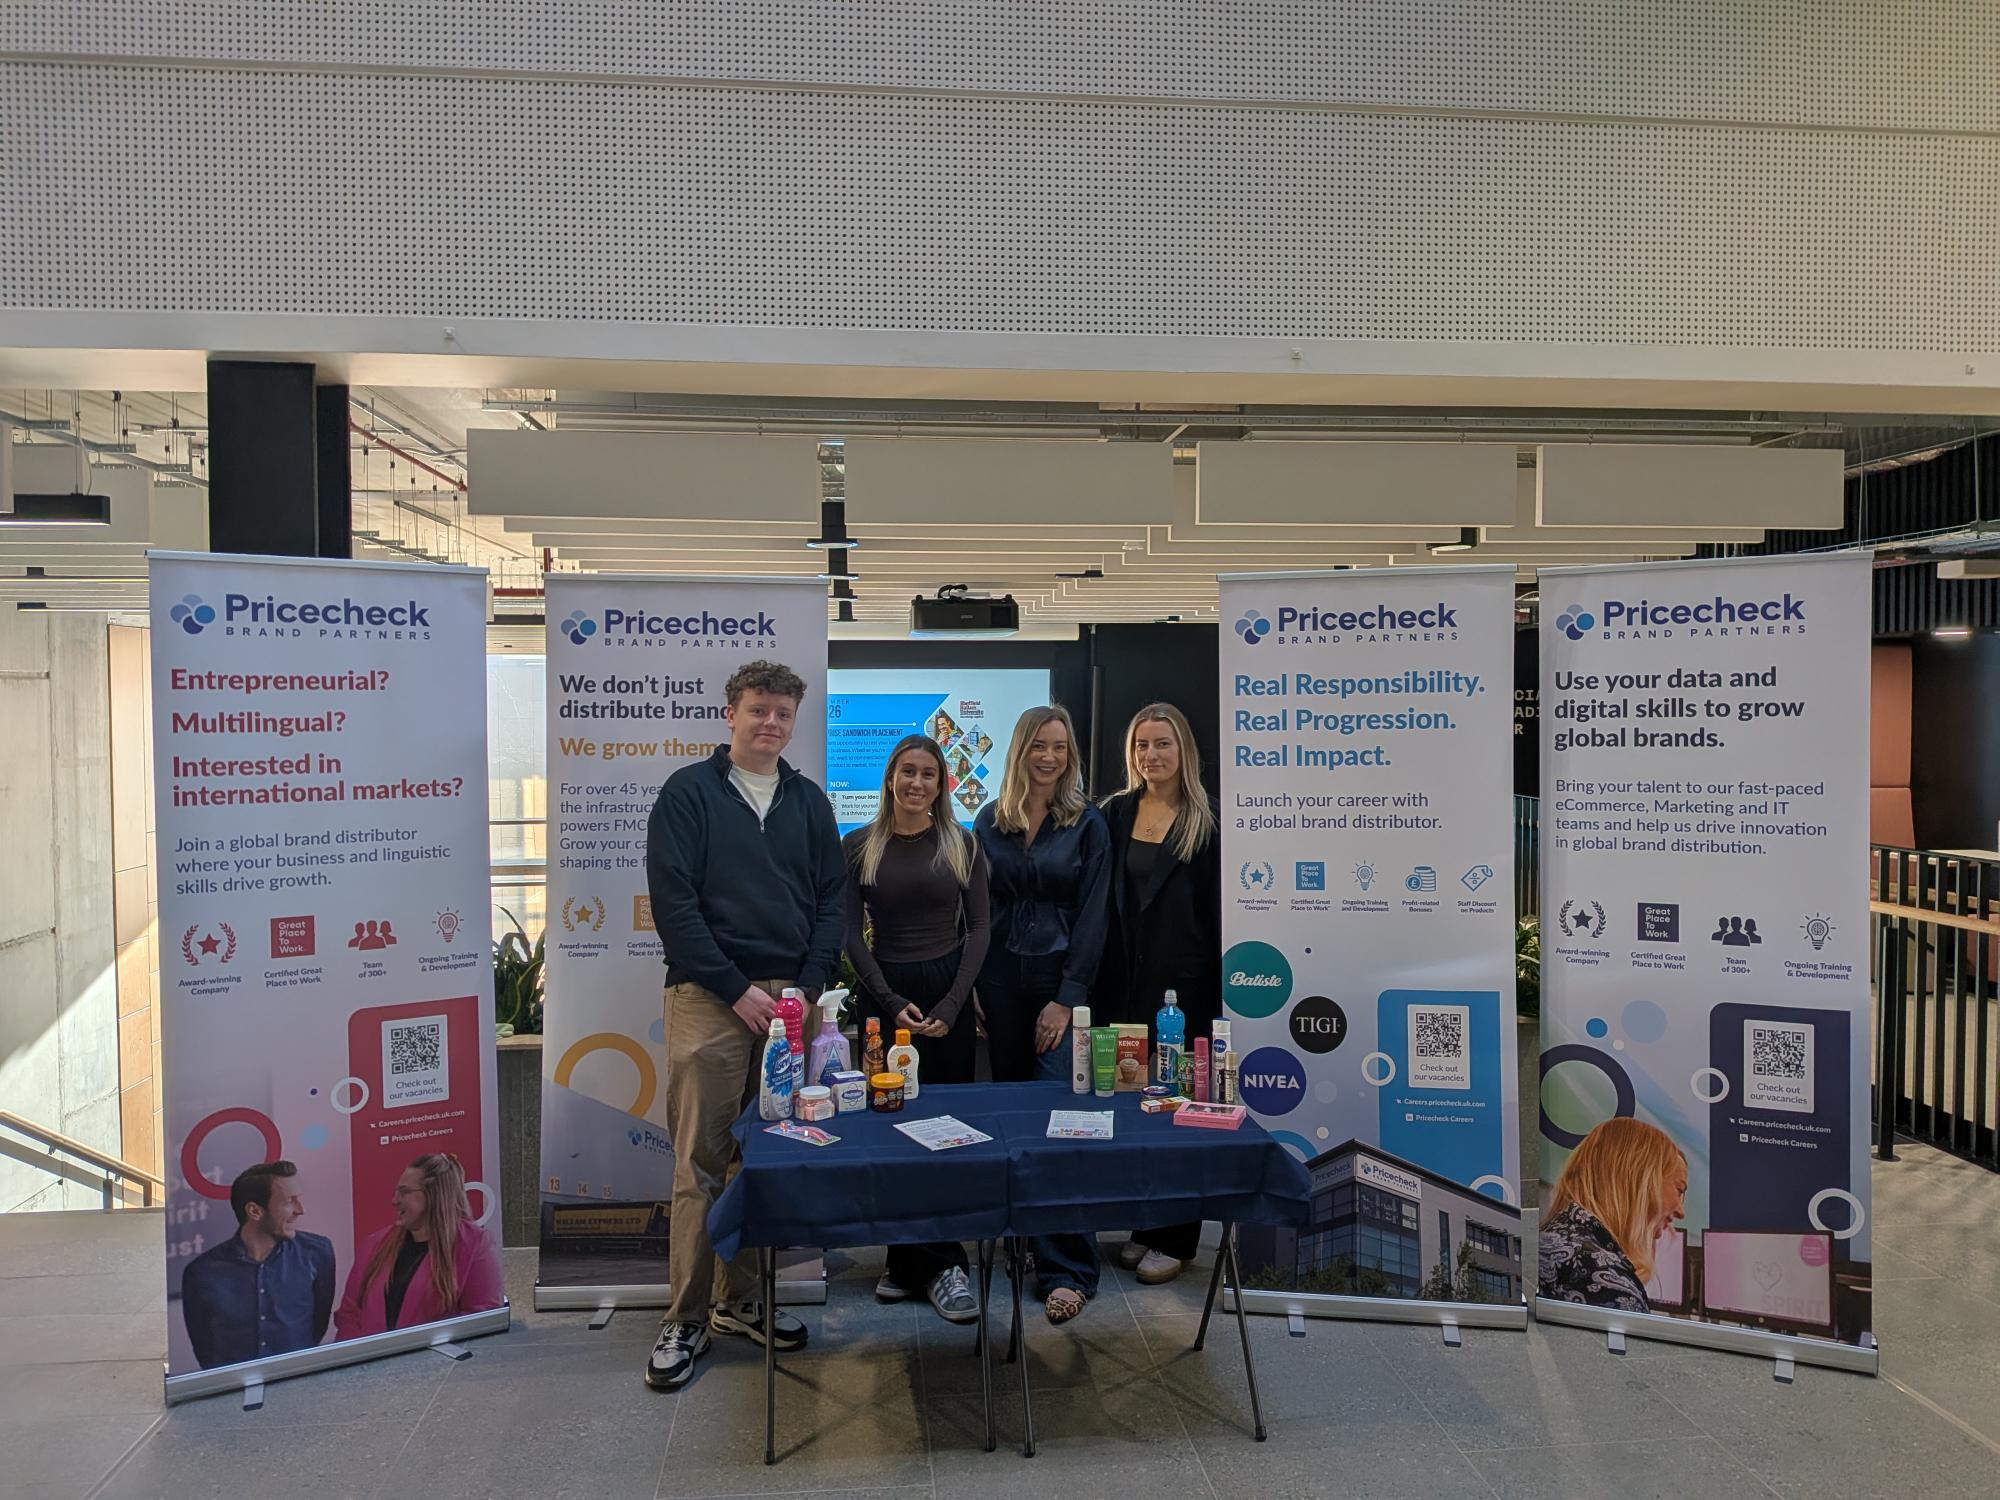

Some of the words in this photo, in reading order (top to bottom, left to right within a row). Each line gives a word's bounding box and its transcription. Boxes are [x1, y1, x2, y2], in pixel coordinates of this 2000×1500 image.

[225, 594, 431, 627] Pricecheck
[1278, 603, 1457, 632] Pricecheck
[1604, 593, 1805, 627] Pricecheck
[604, 609, 776, 637] Pricecheck
[226, 627, 301, 637] BRAND
[320, 629, 431, 640] PARTNERS
[1278, 635, 1341, 644] BRAND
[1356, 632, 1458, 642] PARTNERS
[1604, 628, 1673, 639] BRAND
[1691, 625, 1806, 637] PARTNERS
[605, 638, 666, 647] BRAND
[681, 640, 776, 648] PARTNERS
[171, 669, 390, 694] Entrepreneurial?
[560, 675, 596, 693] We
[603, 675, 658, 694] don't
[663, 676, 703, 697] just
[1235, 674, 1287, 696] Real
[1296, 671, 1484, 698] Responsibility.
[1555, 671, 1599, 689] Use
[1605, 674, 1661, 693] your
[1667, 668, 1722, 688] data
[1730, 666, 1776, 687] and
[560, 700, 665, 719] distribute
[1555, 699, 1628, 722] digital
[1635, 698, 1696, 718] skills
[1704, 699, 1730, 717] to
[1738, 702, 1804, 721] grow
[171, 712, 346, 736] Multilingual?
[1235, 709, 1287, 731] Real
[1296, 708, 1456, 734] Progression.
[1555, 728, 1626, 751] global
[1634, 727, 1724, 747] brands.
[560, 738, 595, 755] We
[602, 740, 657, 759] grow
[173, 754, 310, 777] Interested
[319, 753, 341, 773] in
[1235, 745, 1287, 766] Real
[1296, 745, 1391, 770] Impact.
[173, 780, 345, 806] international
[353, 777, 463, 800] markets?
[560, 784, 581, 795] For
[586, 786, 616, 795] over
[620, 784, 637, 795] 45
[1556, 780, 1594, 794] Bring
[1598, 782, 1632, 795] your
[1637, 780, 1681, 793] talent
[1686, 781, 1702, 794] to
[1707, 783, 1734, 795] our
[1738, 781, 1823, 797] fast-paced
[560, 801, 582, 813] the
[1236, 793, 1292, 807] Launch
[1297, 795, 1333, 810] your
[1337, 795, 1388, 807] career
[1393, 793, 1428, 807] with
[1556, 800, 1649, 814] eCommerce,
[1654, 800, 1734, 816] Marketing
[1739, 801, 1768, 814] and
[1773, 802, 1789, 814] IT
[560, 821, 609, 834] powers
[615, 820, 648, 831] FMC
[1236, 817, 1244, 829] a
[1249, 814, 1296, 831] global
[1301, 814, 1347, 828] brand
[1352, 814, 1442, 828] distributor.
[1556, 818, 1599, 830] teams
[1604, 818, 1632, 831] and
[1636, 819, 1669, 834] help
[1674, 821, 1691, 832] us
[1696, 820, 1736, 834] drive
[1740, 821, 1826, 836] innovation
[176, 837, 210, 852] Join
[215, 839, 224, 850] a
[230, 835, 279, 852] global
[284, 831, 330, 847] brand
[335, 827, 417, 844] distributor
[560, 838, 596, 850] Grow
[600, 840, 631, 852] your
[1556, 837, 1568, 848] in
[1573, 836, 1617, 851] global
[1622, 837, 1666, 851] brand
[1671, 838, 1766, 854] distribution.
[176, 857, 229, 872] where
[235, 855, 270, 871] your
[276, 852, 345, 867] business
[350, 848, 377, 863] and
[383, 845, 450, 862] linguistic
[560, 857, 611, 870] shaping
[616, 856, 638, 867] the
[176, 878, 217, 894] skills
[223, 875, 265, 891] drive
[270, 872, 331, 887] growth.
[1645, 907, 1670, 916] Great
[278, 921, 306, 930] Great
[279, 929, 306, 937] Place
[1646, 922, 1654, 930] To
[279, 937, 290, 945] To
[1646, 929, 1668, 938] Work
[279, 944, 304, 953] Work
[1556, 948, 1610, 958] Award-winning
[1566, 957, 1599, 966] Company
[1631, 952, 1663, 961] Certified
[1665, 953, 1686, 961] Great
[1726, 957, 1746, 965] Team
[1632, 960, 1653, 968] Place
[1664, 961, 1684, 970] Work
[1731, 966, 1751, 974] 300+
[1230, 972, 1282, 987] Batiste
[1296, 1016, 1338, 1033] TIGI
[1420, 1064, 1442, 1073] Check
[396, 1079, 421, 1089] Check
[423, 1078, 436, 1086] out
[1244, 1075, 1300, 1089] NIVEA
[1428, 1074, 1464, 1082] vacancies
[390, 1092, 402, 1100] our
[405, 1087, 443, 1098] vacancies
[1757, 1083, 1783, 1093] Check
[1786, 1085, 1800, 1094] out
[1750, 1092, 1764, 1100] our
[1766, 1093, 1807, 1105] vacancies
[392, 1131, 427, 1143] Pricecheck
[429, 1127, 453, 1138] Careers
[1751, 1135, 1789, 1146] Pricecheck
[1791, 1139, 1817, 1148] Careers
[1315, 1161, 1352, 1183] Pricecheck
[1373, 1165, 1418, 1189] Pricecheck
